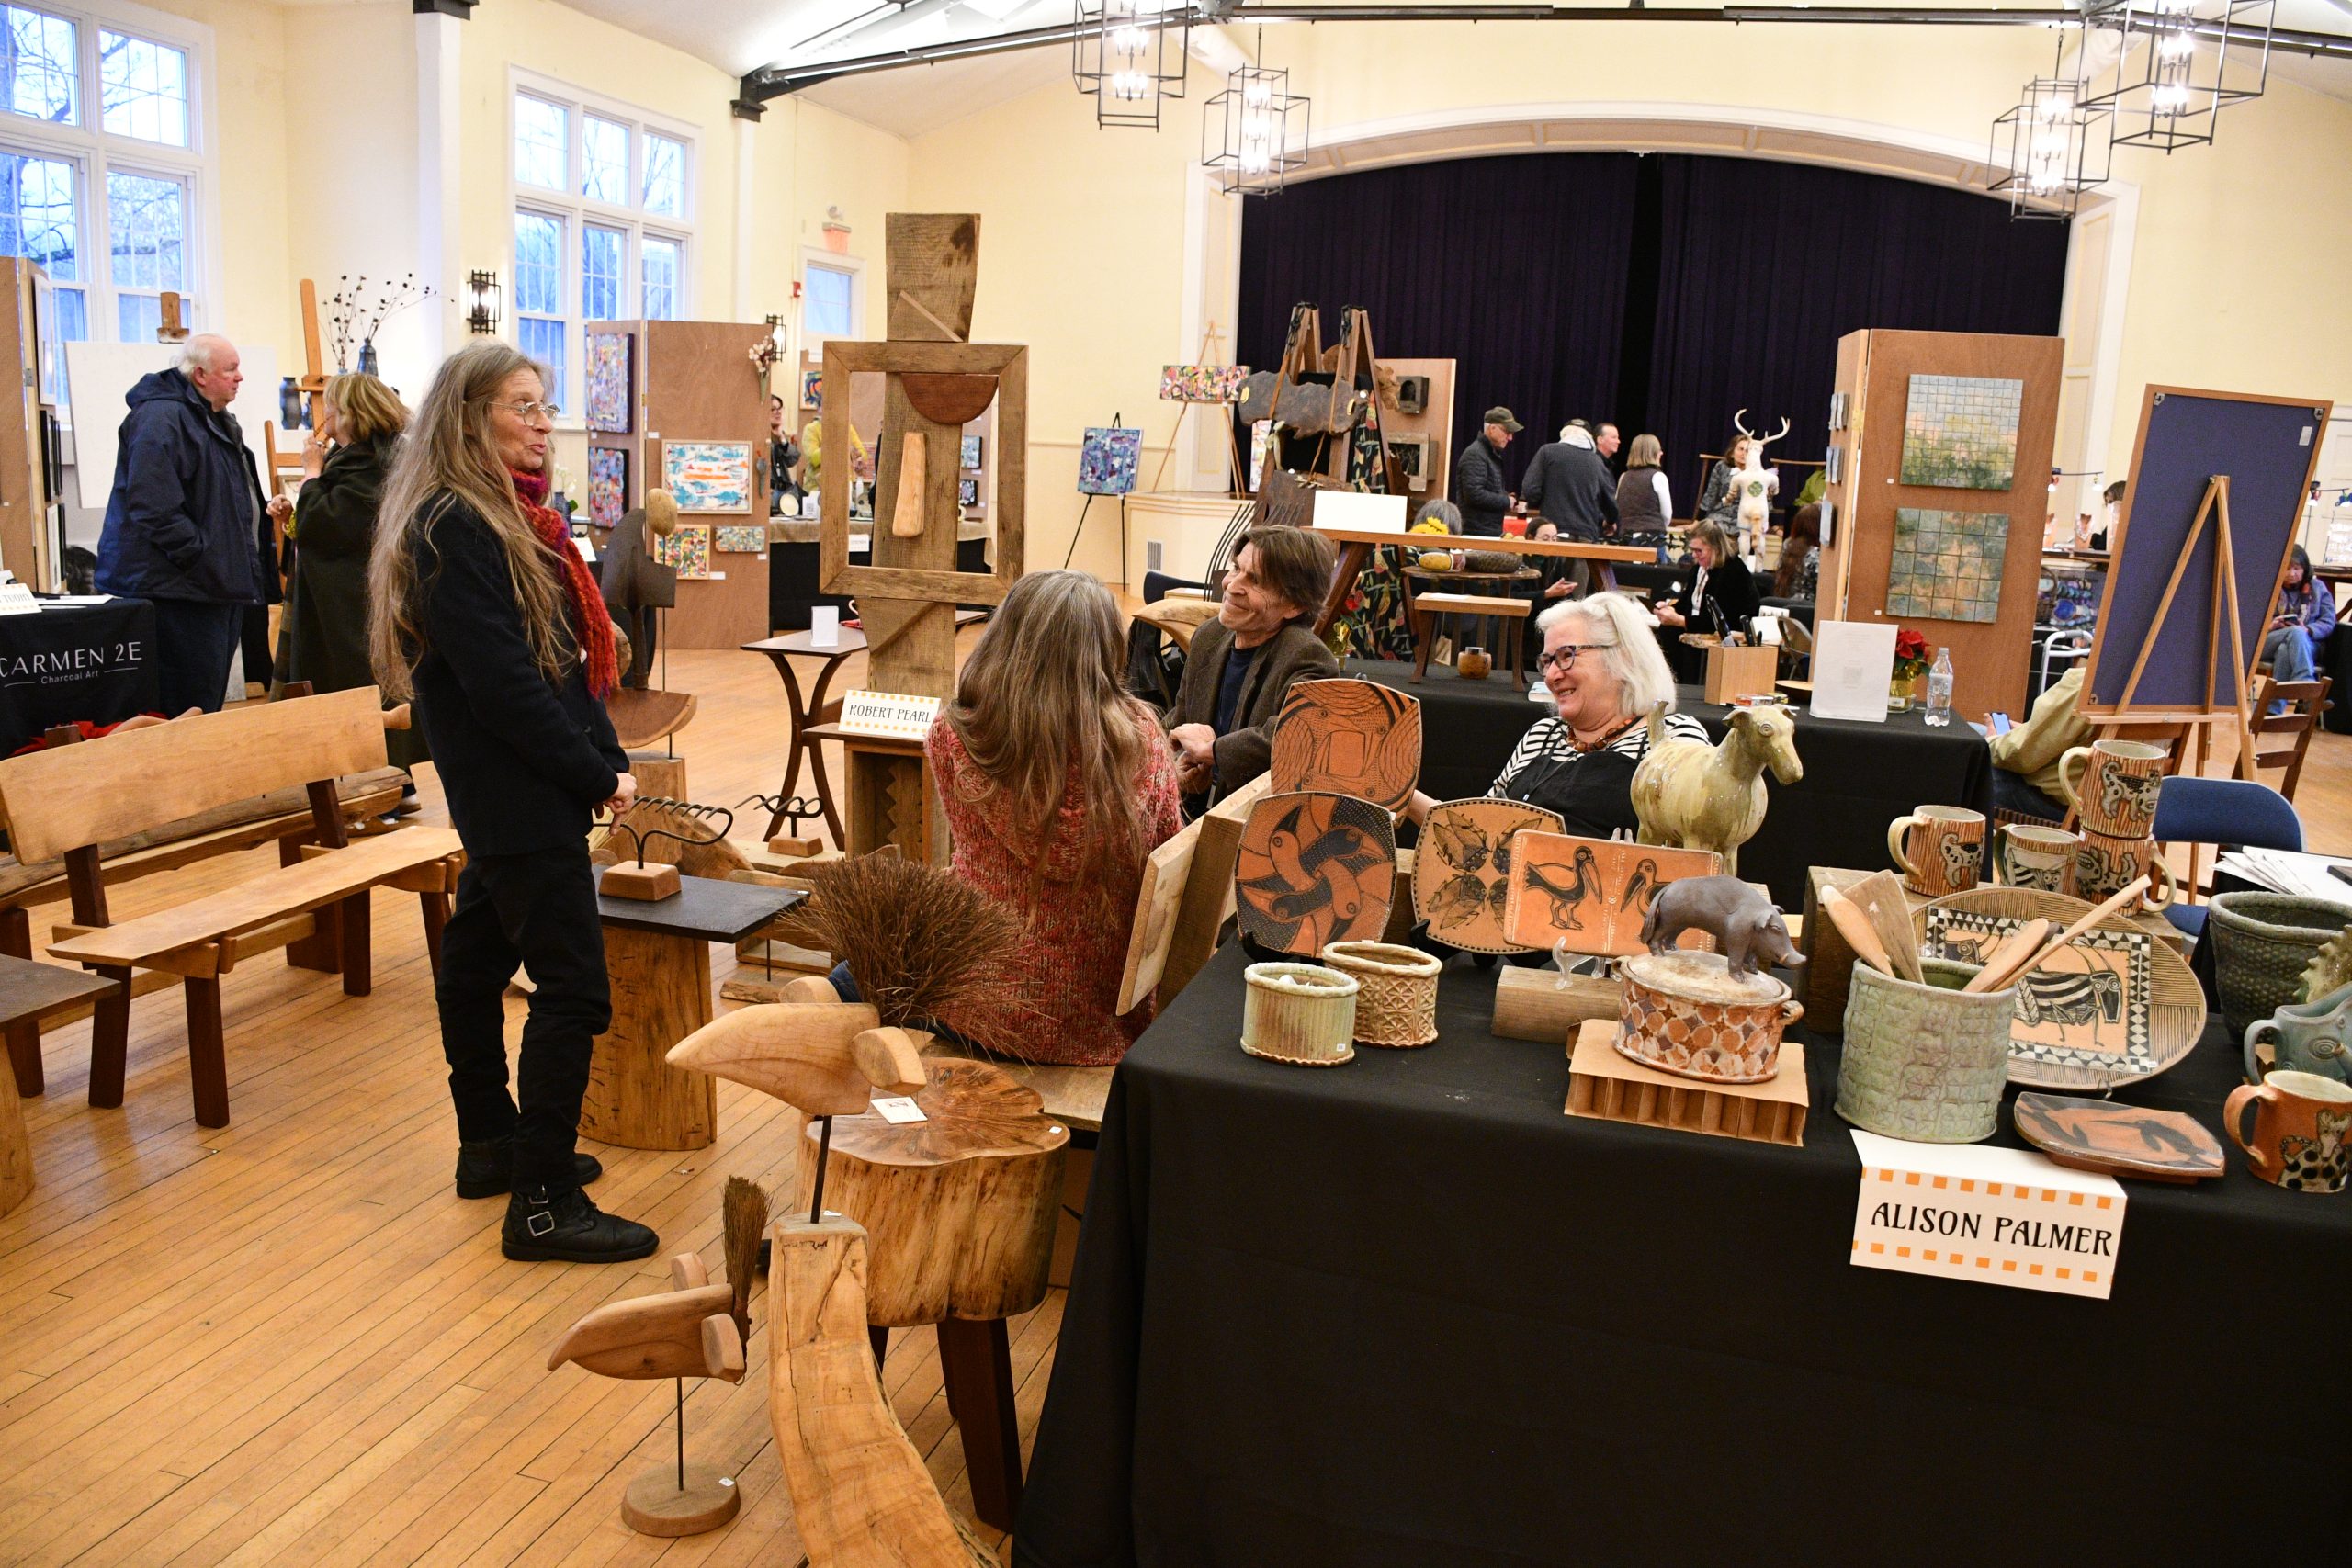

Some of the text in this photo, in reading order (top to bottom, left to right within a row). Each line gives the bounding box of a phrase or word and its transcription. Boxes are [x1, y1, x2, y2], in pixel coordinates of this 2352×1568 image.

[115, 642, 142, 661] 2E
[40, 670, 99, 684] Charcoal Art
[849, 704, 931, 722] ROBERT PEARL
[1871, 1201, 2112, 1257] ALISON PALMER
